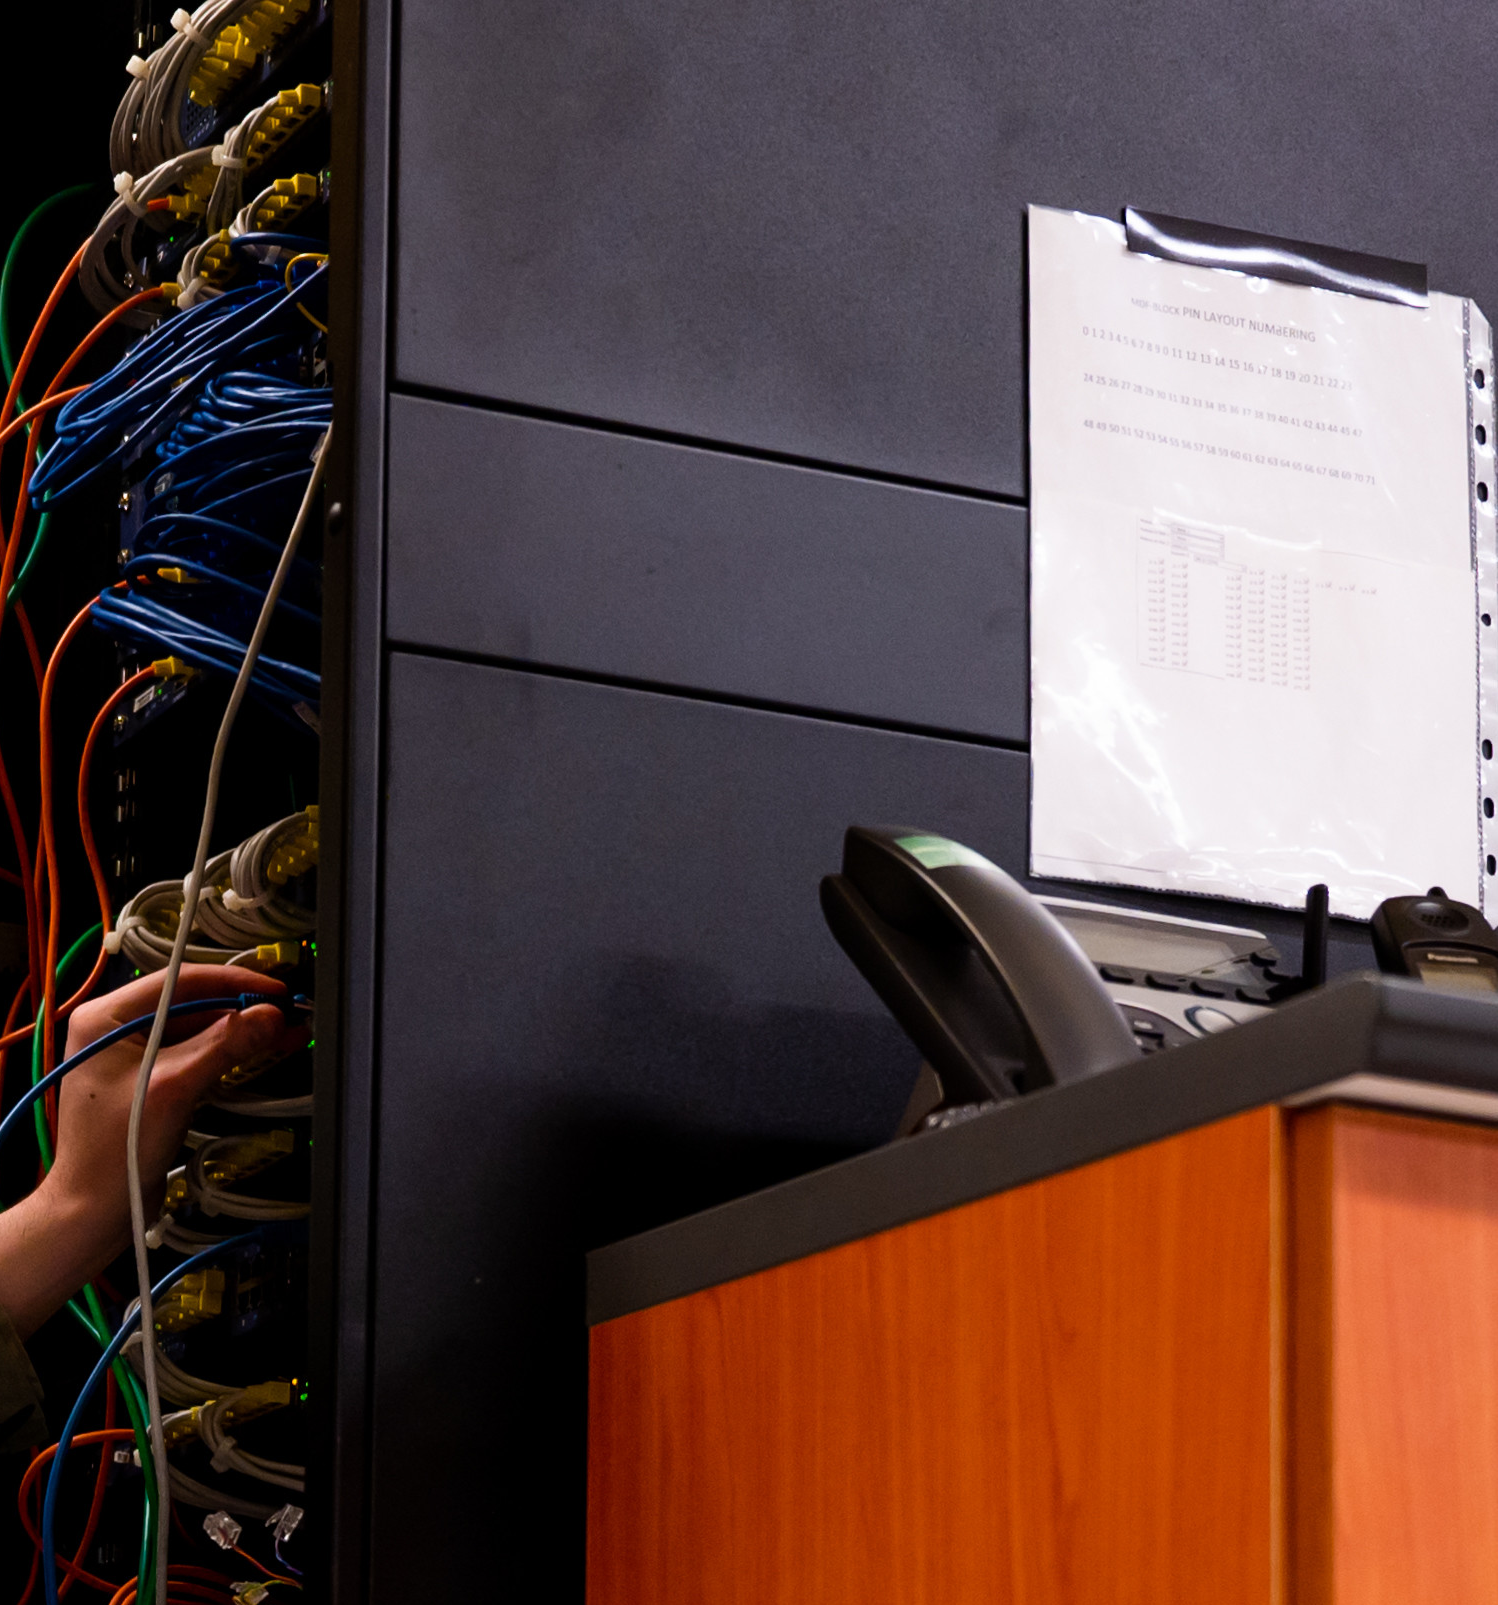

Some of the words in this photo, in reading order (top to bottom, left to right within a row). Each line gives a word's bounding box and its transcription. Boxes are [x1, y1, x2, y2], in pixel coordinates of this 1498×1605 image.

[1182, 306, 1201, 320] PIN
[1203, 310, 1246, 329] LAYOUT
[1248, 320, 1316, 343] NUMBERING
[1082, 325, 1089, 336] 0
[1092, 327, 1097, 338] 1
[1099, 329, 1106, 340] 2
[1109, 331, 1114, 342] 3
[1115, 333, 1122, 343] 4
[1123, 335, 1129, 345] 5
[1131, 338, 1137, 348] 6
[1139, 340, 1145, 349] 7
[1147, 342, 1153, 352] 8
[1155, 343, 1161, 354] 9
[1162, 345, 1169, 356] 0
[1172, 348, 1183, 359] 11
[1186, 350, 1197, 362] 12
[1200, 353, 1211, 364] 13
[1214, 356, 1225, 366] 14
[1229, 359, 1240, 370] 15
[1243, 361, 1254, 373] 16
[1257, 365, 1268, 375] 17
[1271, 367, 1282, 378] 18
[1285, 370, 1296, 381] 19
[1298, 373, 1311, 383] 20
[1313, 375, 1324, 386] 21
[1327, 378, 1339, 389] 22
[1341, 380, 1352, 391] 23
[1083, 419, 1094, 429] 48
[1096, 421, 1107, 431] 49
[1108, 424, 1120, 434] 50
[1121, 426, 1132, 436] 51
[1134, 428, 1144, 439] 52
[1146, 431, 1156, 441] 53
[1158, 435, 1168, 445] 54
[1169, 437, 1179, 448] 55
[1181, 439, 1192, 450] 56
[1193, 442, 1204, 452] 57
[1206, 444, 1216, 455] 58
[1218, 447, 1229, 457] 59
[1230, 449, 1241, 460] 60
[1242, 452, 1252, 463] 61
[1254, 454, 1265, 465] 62
[1267, 456, 1278, 467] 63
[1280, 458, 1291, 468] 64
[1292, 460, 1302, 471] 65
[1304, 463, 1315, 474] 66
[1316, 466, 1327, 475] 67
[1329, 468, 1339, 479] 68
[1341, 471, 1352, 480] 69
[1354, 472, 1364, 483] 70
[1366, 475, 1375, 485] 71
